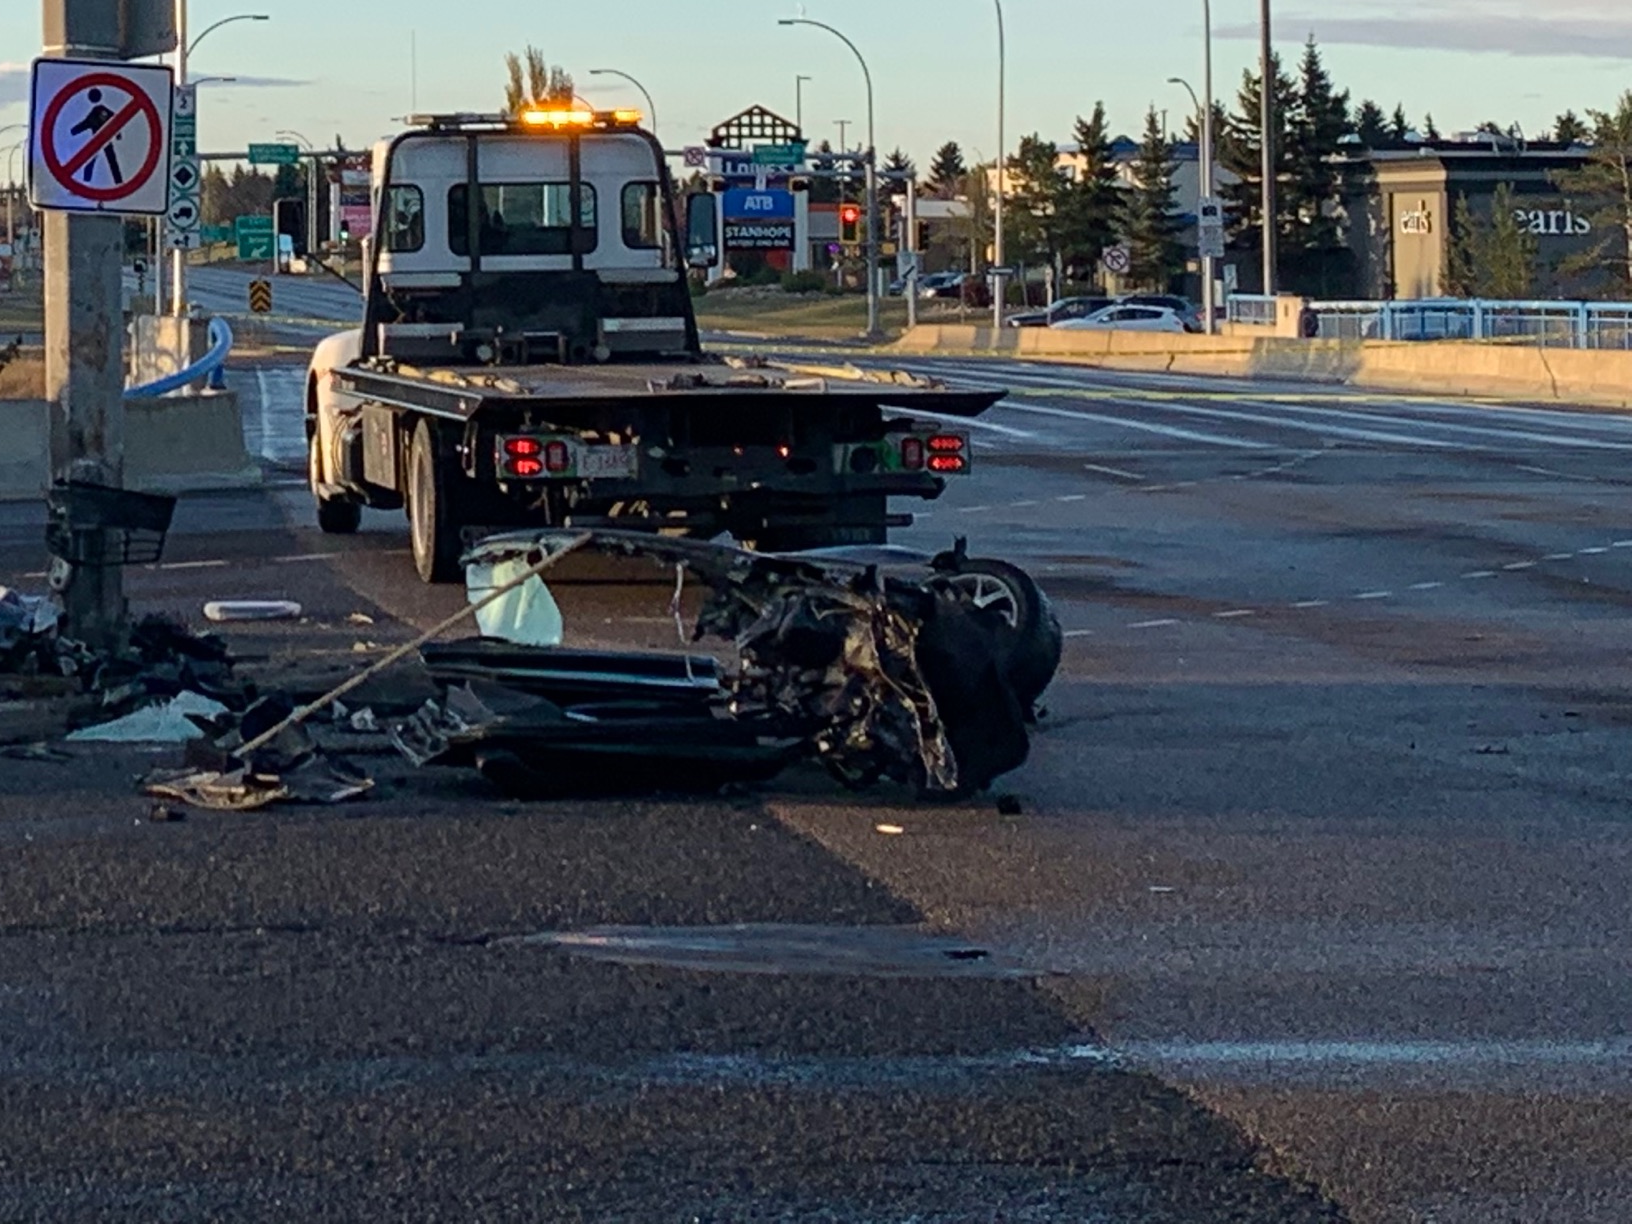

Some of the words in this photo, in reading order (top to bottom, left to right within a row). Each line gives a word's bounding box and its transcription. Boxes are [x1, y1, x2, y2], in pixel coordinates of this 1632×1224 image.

[743, 195, 774, 210] ATB
[1511, 199, 1591, 234] earls
[724, 226, 793, 239] STANHOPE
